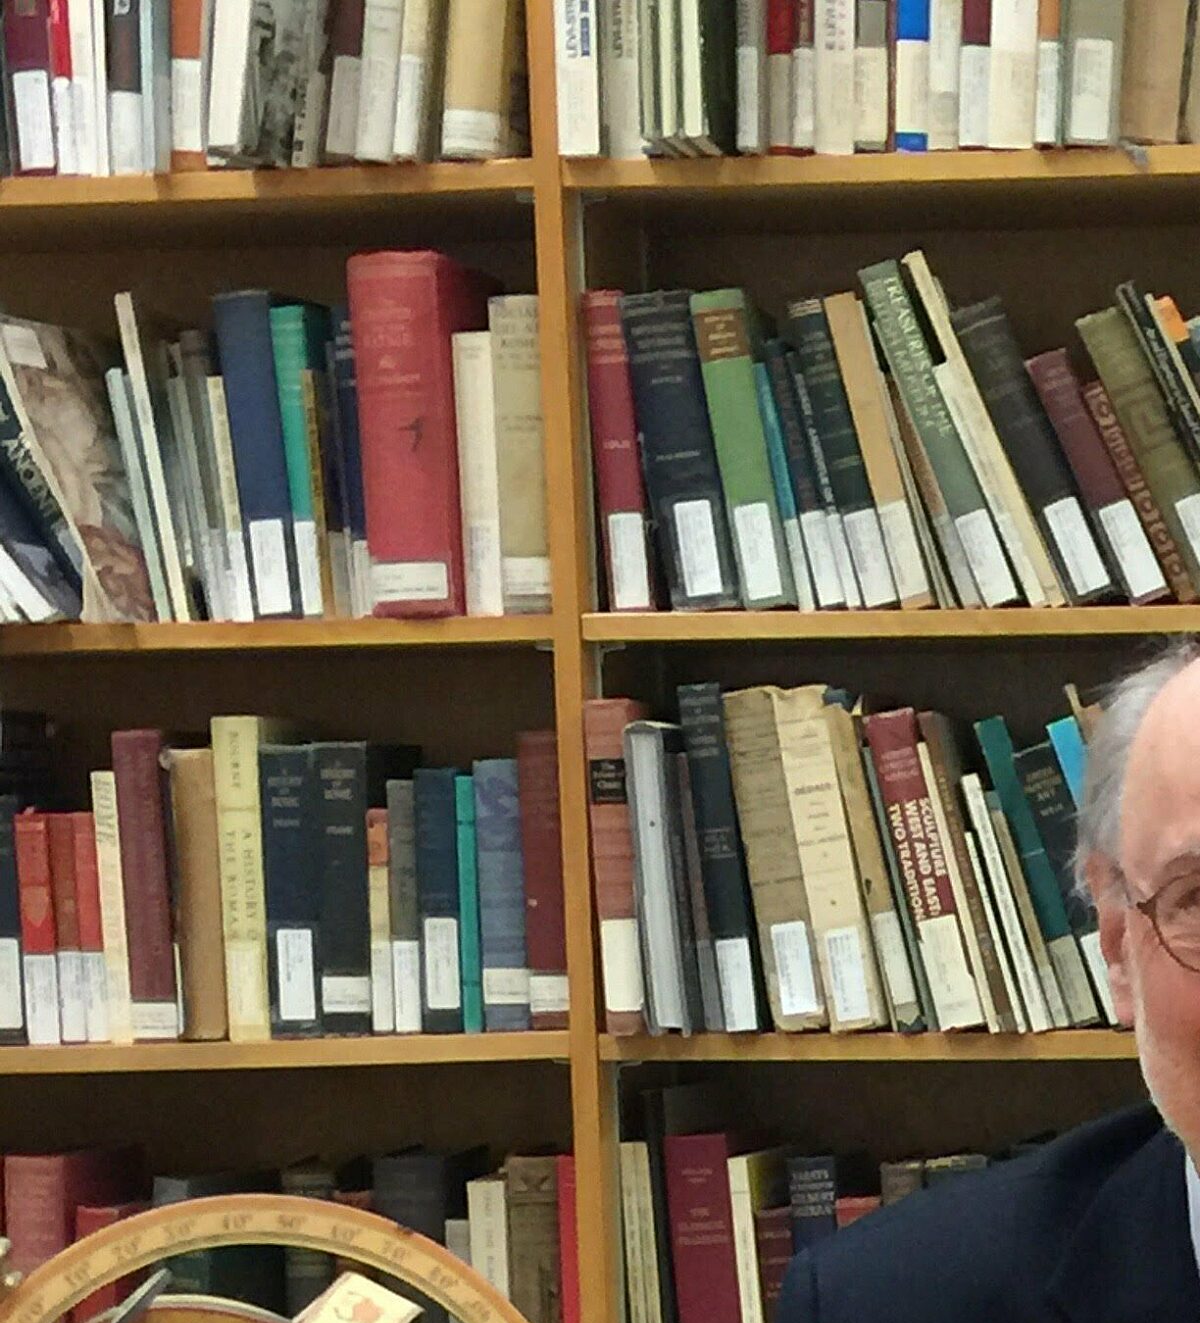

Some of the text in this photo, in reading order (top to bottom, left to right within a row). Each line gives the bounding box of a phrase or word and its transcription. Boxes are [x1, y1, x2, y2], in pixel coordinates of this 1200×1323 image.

[881, 274, 932, 371] TREASURES
[888, 803, 908, 841] TWO
[904, 800, 925, 840] WEST
[919, 797, 947, 877] SCULPTURE
[243, 849, 258, 919] HISTORY
[914, 841, 933, 876] AND
